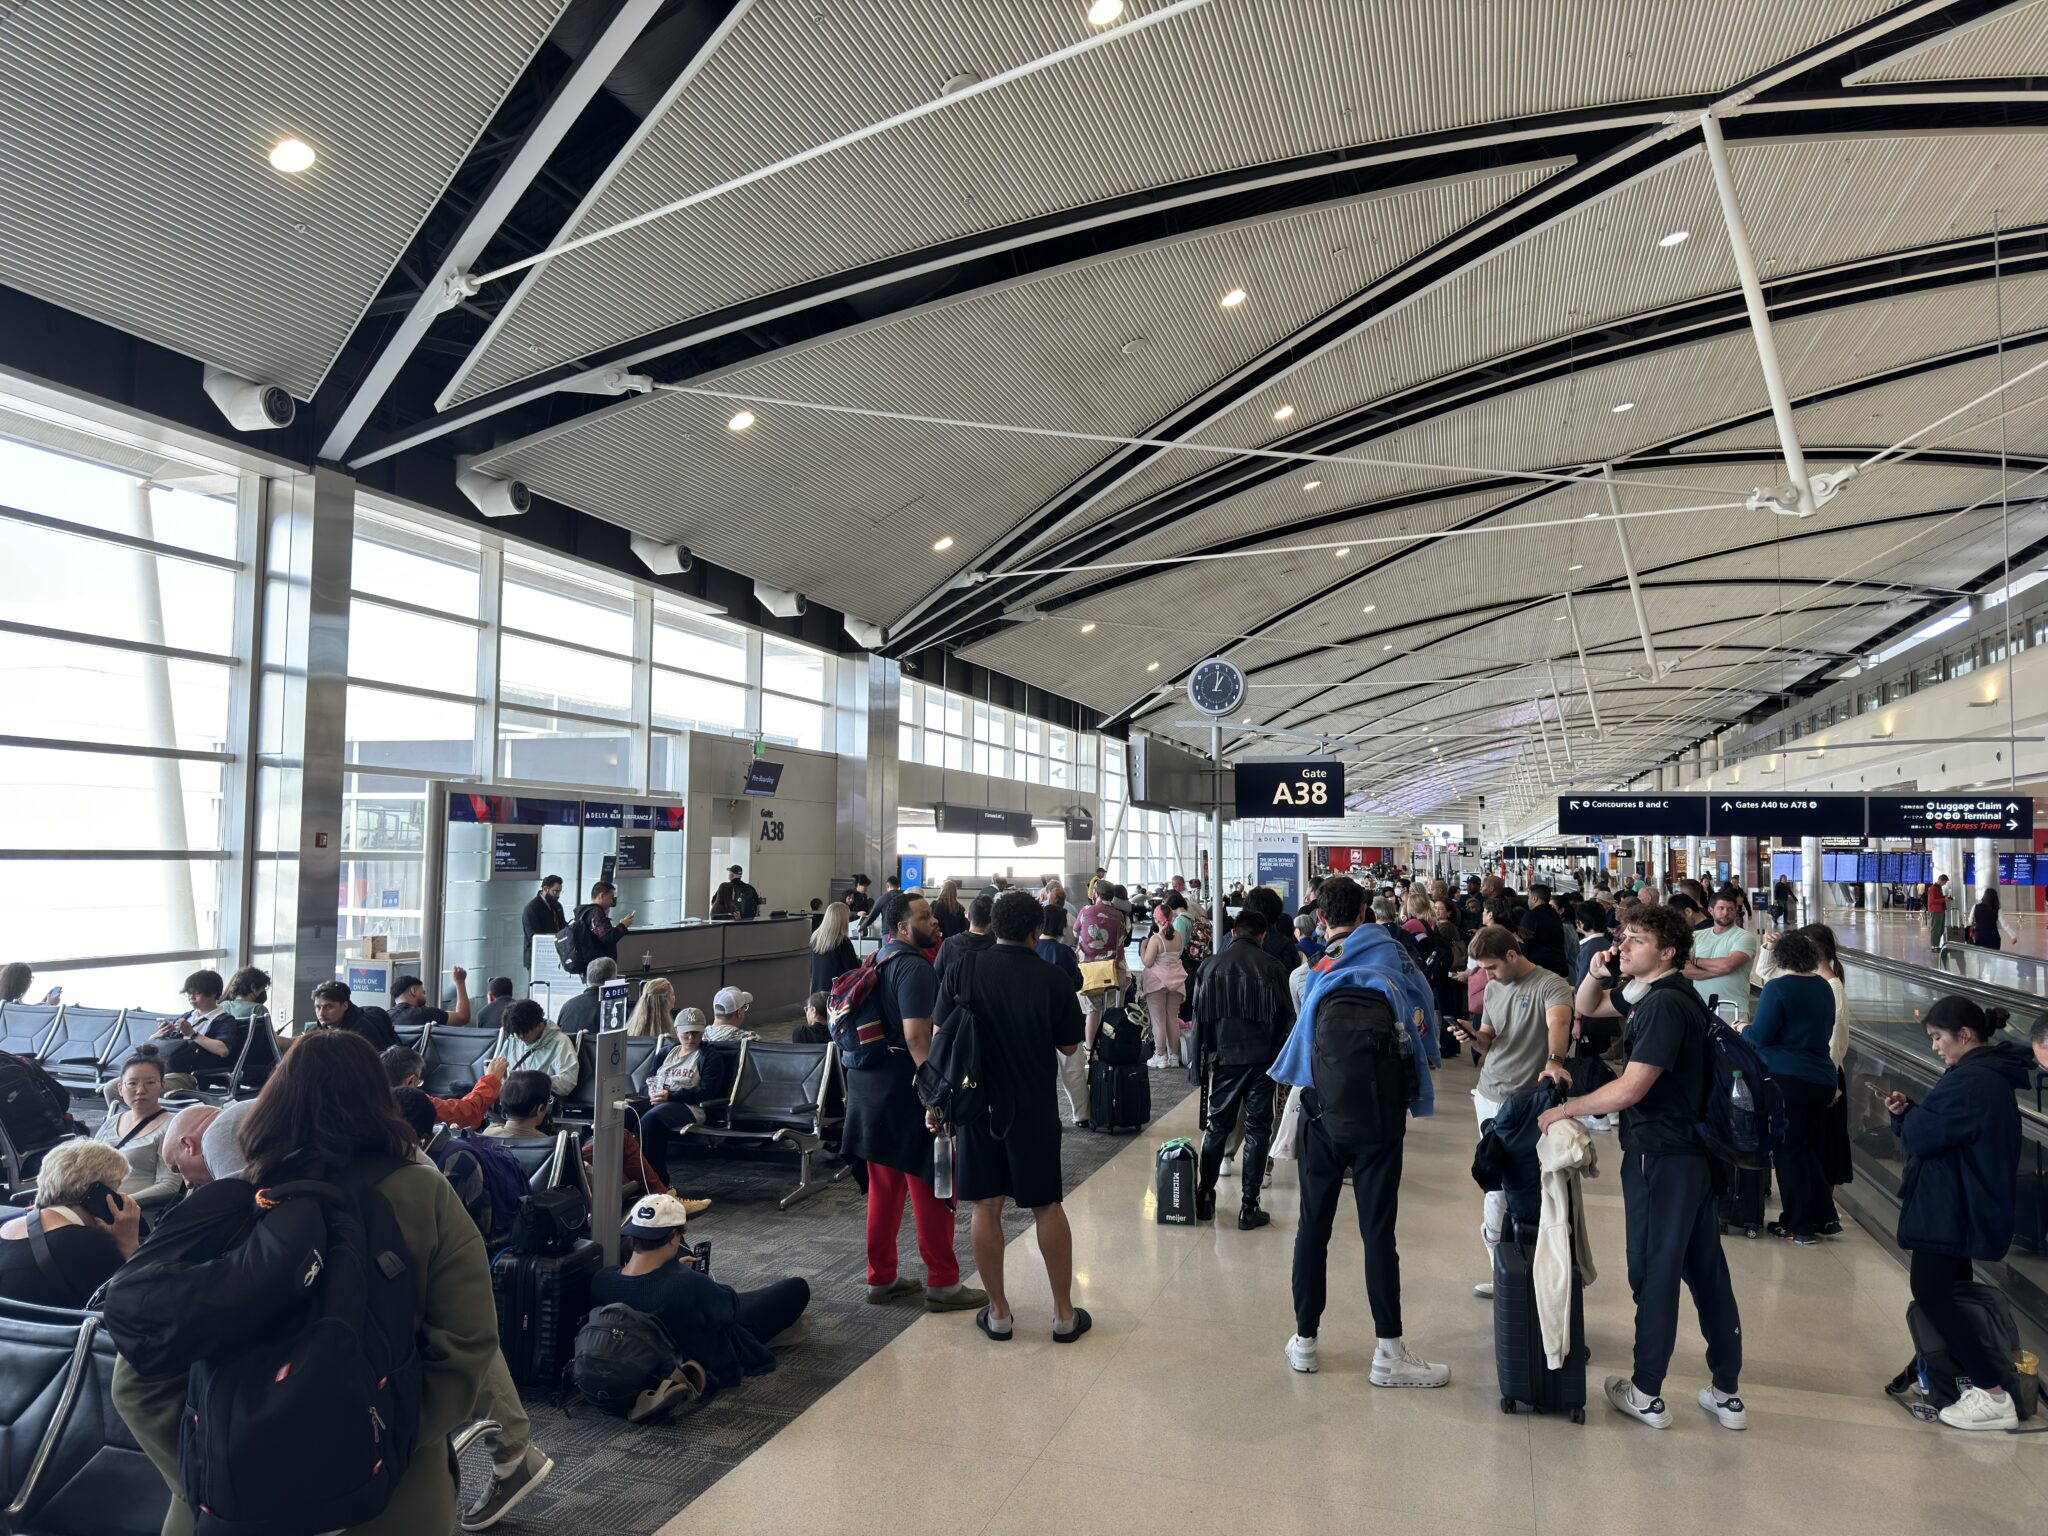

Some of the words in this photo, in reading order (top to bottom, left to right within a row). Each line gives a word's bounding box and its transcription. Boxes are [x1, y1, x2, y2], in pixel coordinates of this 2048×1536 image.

[1301, 768, 1328, 779] Gate
[751, 774, 775, 785] Pre-Boarding
[1272, 781, 1328, 806] A38
[1591, 800, 1637, 809] Concourses
[1638, 801, 1644, 809] B
[1645, 801, 1661, 809] and
[1662, 801, 1669, 809] C
[1735, 801, 1759, 809] Gates
[1760, 801, 1778, 809] A40
[1779, 801, 1789, 809] to
[1790, 801, 1808, 809] A78
[1936, 802, 1975, 812] Luggage
[1976, 802, 2002, 810] Claim
[760, 808, 774, 818] Gate
[1963, 812, 2002, 820] Terminal
[760, 820, 785, 841] A38
[1945, 822, 1978, 831] Express
[1980, 822, 2001, 830] Tram
[353, 977, 367, 985] HAVE
[1166, 1214, 1187, 1222] meijer
